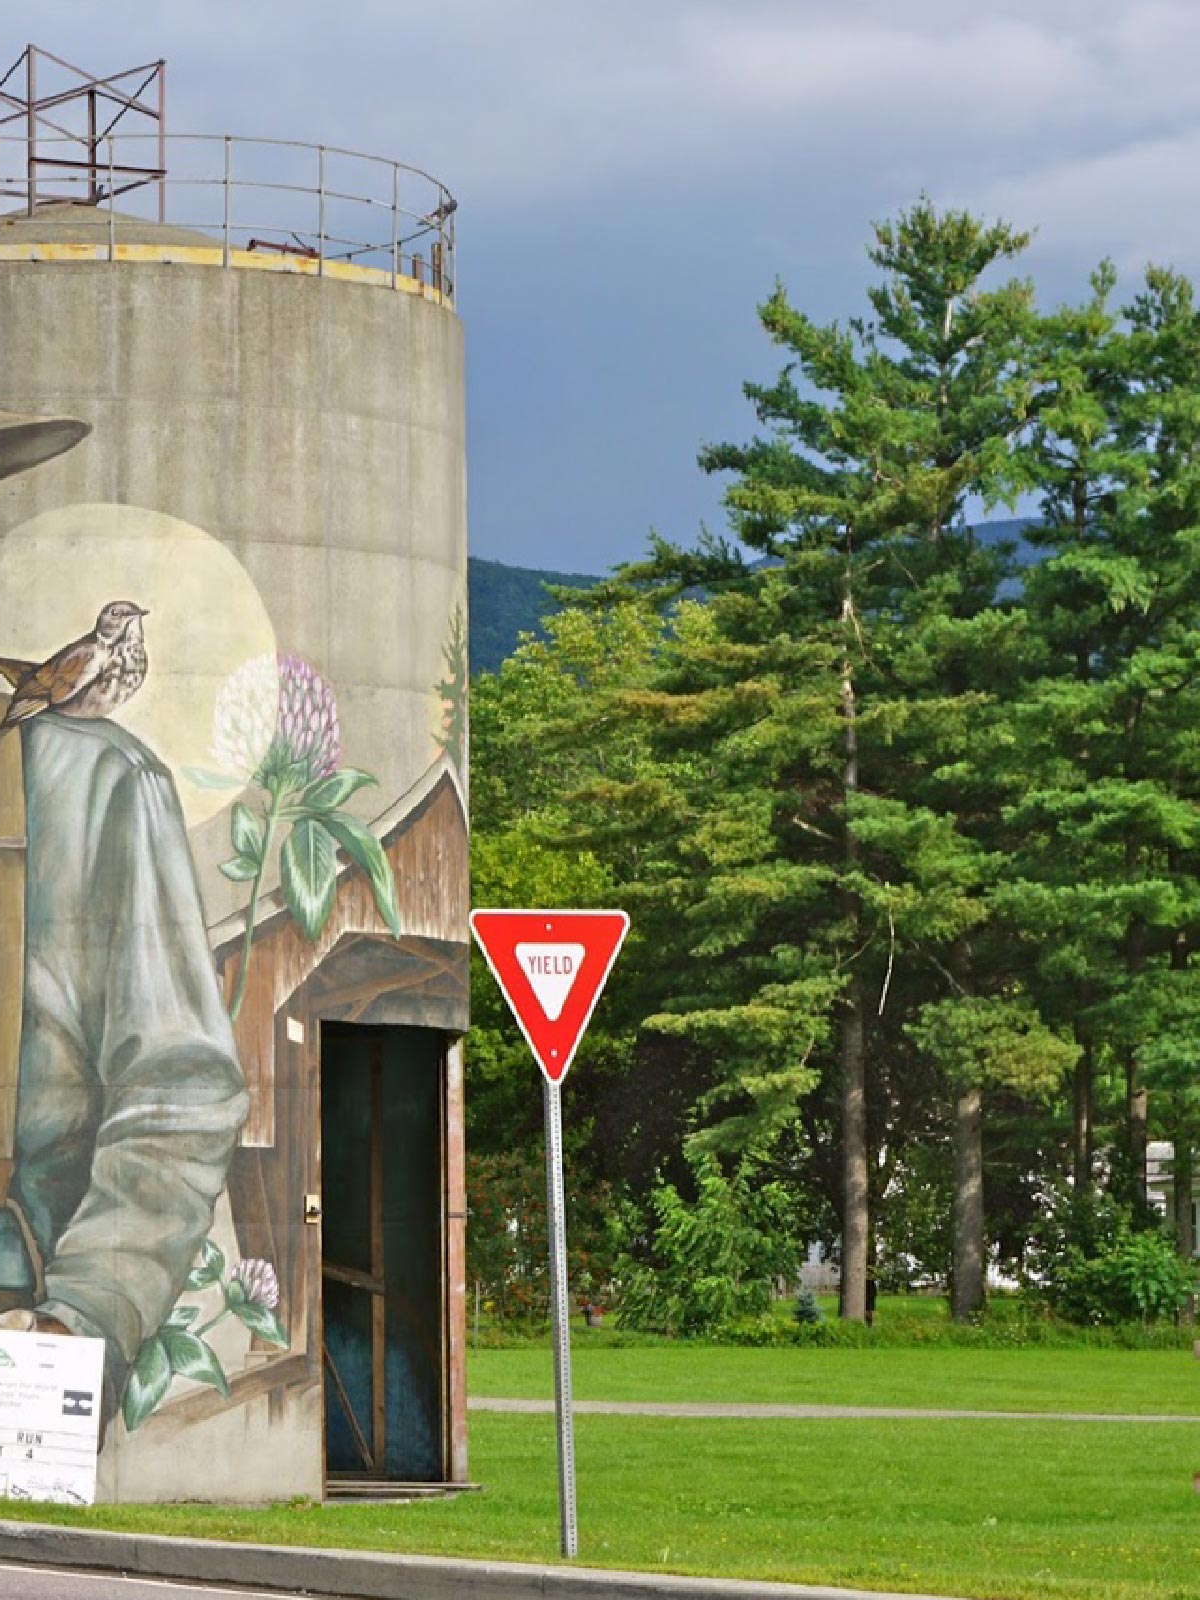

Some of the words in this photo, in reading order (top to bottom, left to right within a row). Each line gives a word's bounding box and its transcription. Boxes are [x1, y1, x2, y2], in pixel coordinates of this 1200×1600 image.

[527, 955, 573, 975] YIELD
[16, 1432, 43, 1444] RUN
[25, 1447, 33, 1459] 4
